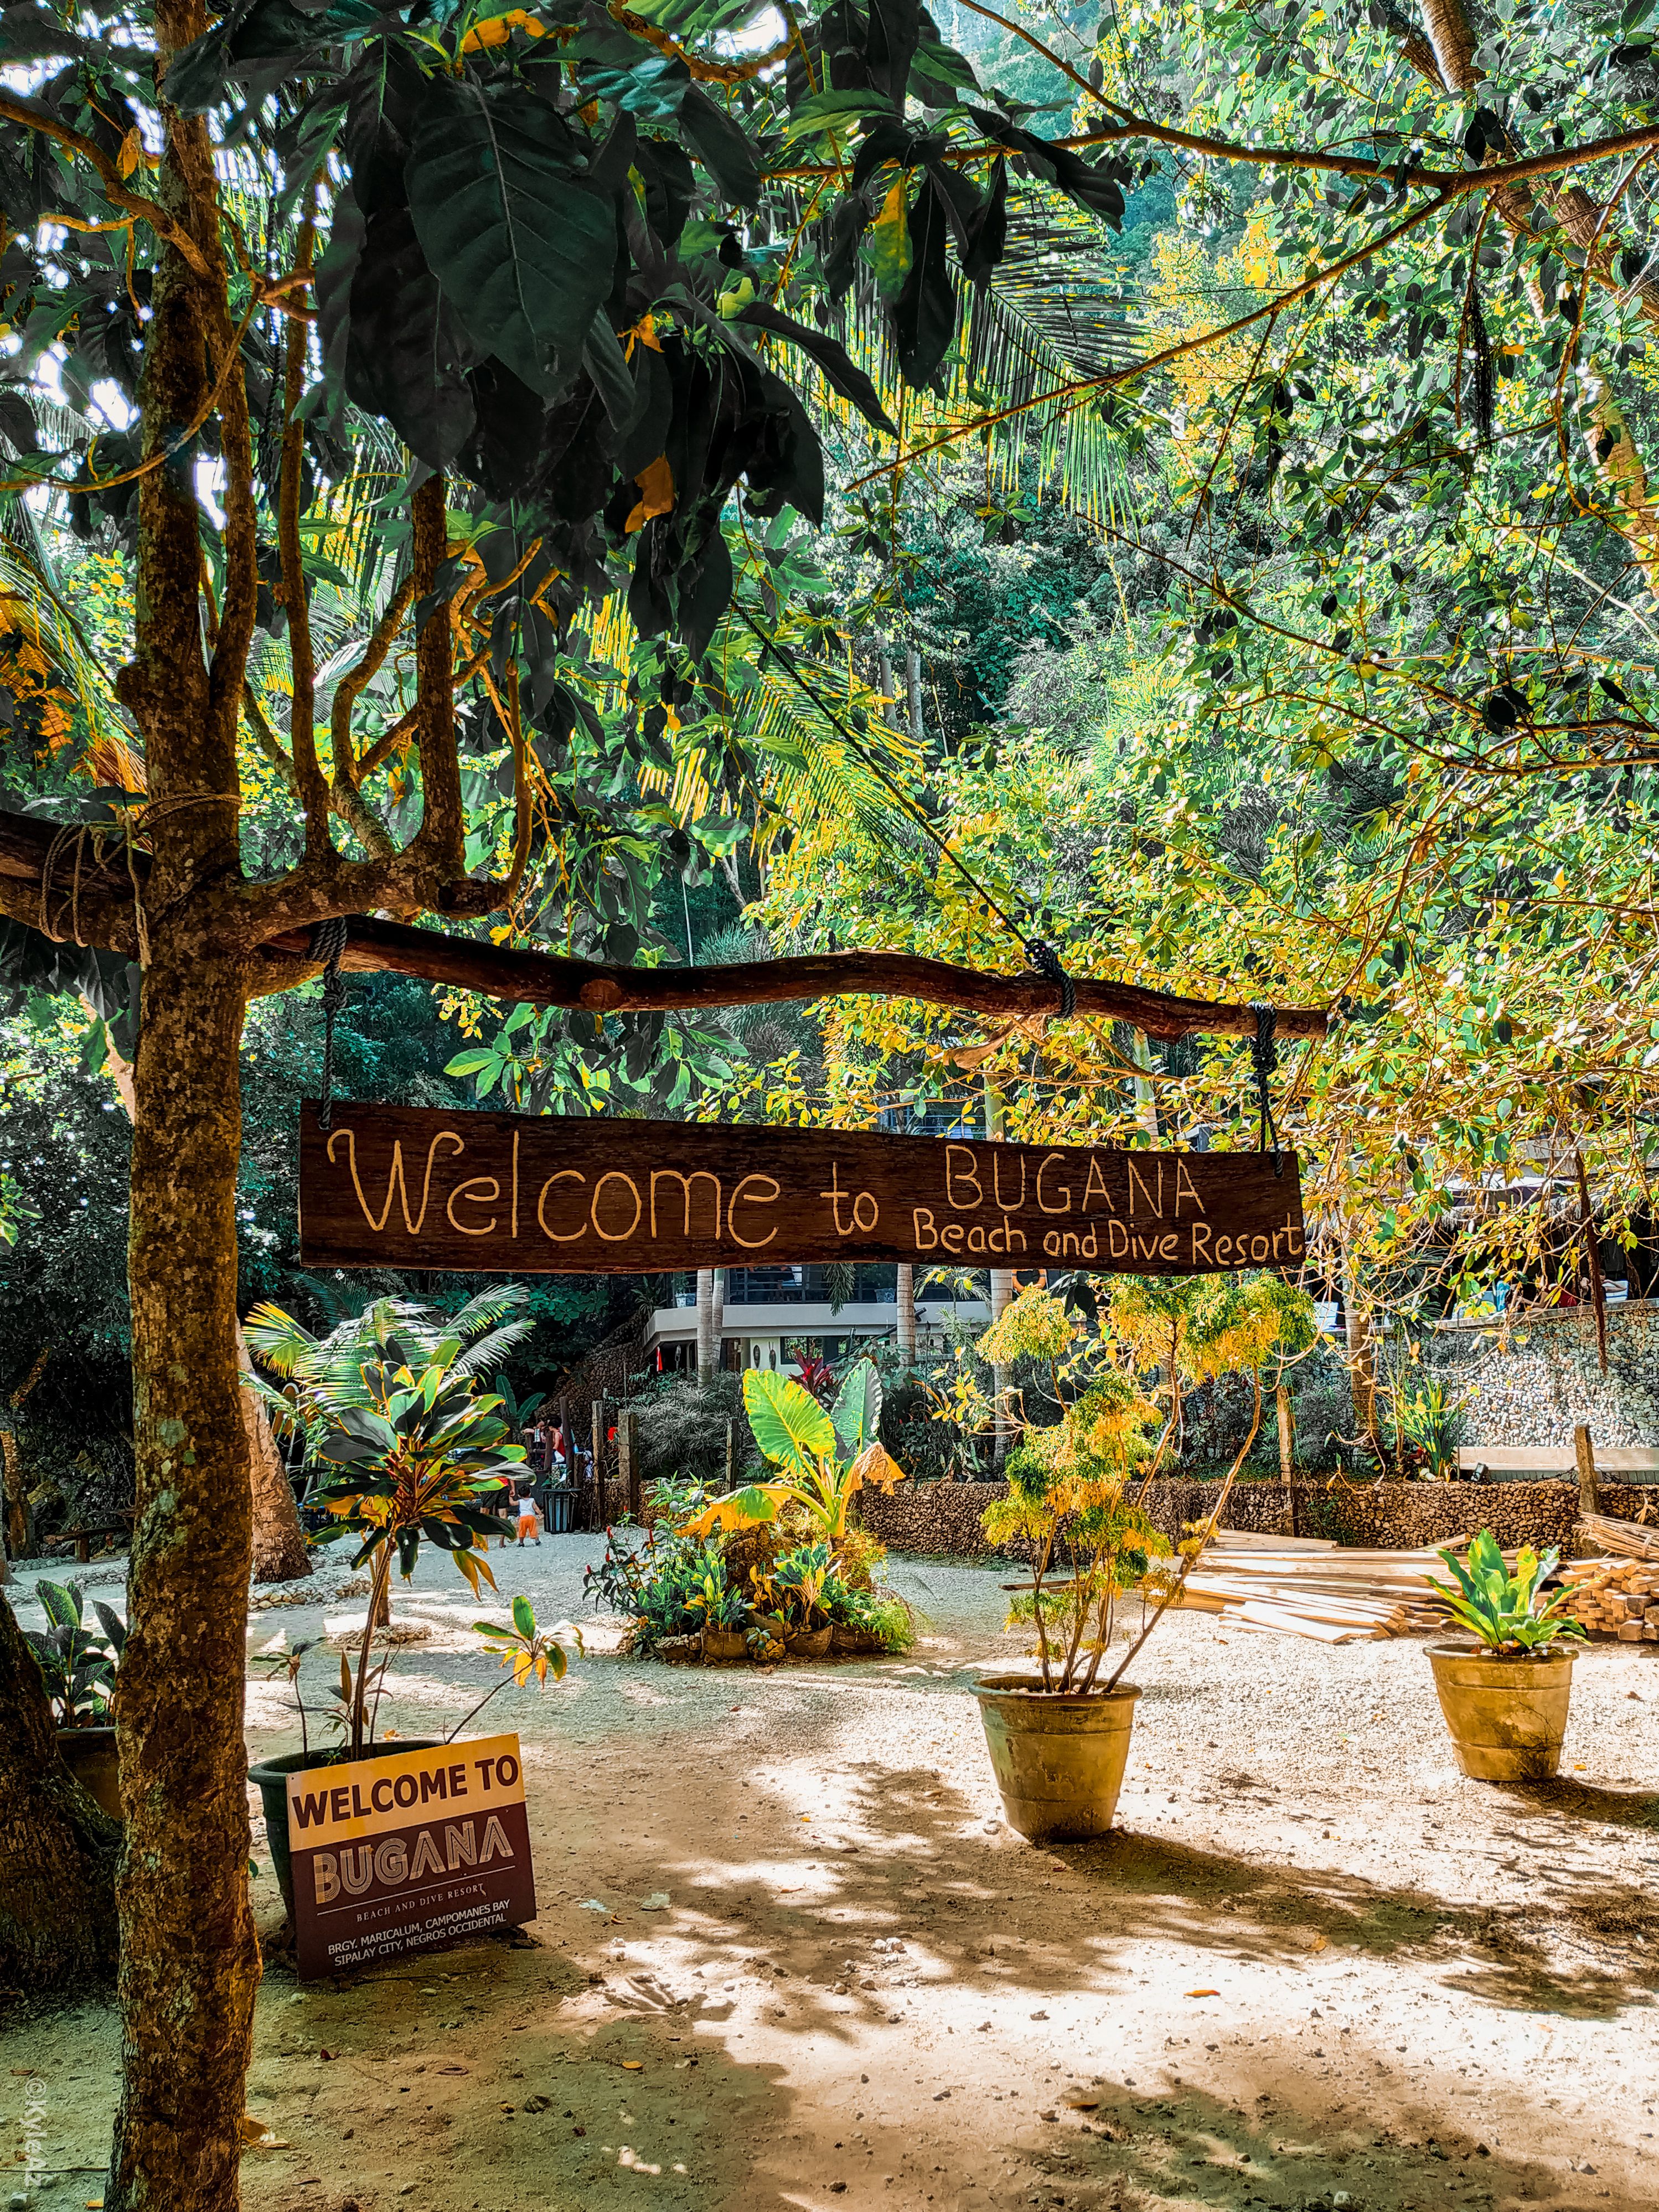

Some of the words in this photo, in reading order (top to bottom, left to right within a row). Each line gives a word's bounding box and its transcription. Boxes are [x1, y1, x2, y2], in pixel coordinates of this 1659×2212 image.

[327, 1129, 781, 1248] Welcome
[819, 1161, 880, 1236] to
[945, 1144, 1206, 1218] BUGANA
[913, 1207, 1027, 1253] Beach
[1042, 1222, 1098, 1259] and
[1108, 1218, 1179, 1261] Dive
[1192, 1212, 1304, 1266] Resort
[292, 1764, 468, 1829] WELCOME
[474, 1754, 519, 1791] TO
[313, 1815, 514, 1905] BUGANA
[328, 1939, 358, 1955] BRGY.
[361, 1922, 423, 1947] MARICALUM,
[425, 1904, 491, 1929] CAMPOMANES
[493, 1899, 510, 1912] BAY
[356, 1906, 391, 1922] BEACH
[395, 1901, 415, 1913] AND
[419, 1893, 443, 1906] DIVE
[447, 1883, 484, 1899] RESORT
[334, 1947, 376, 1966] SIPALAY
[378, 1940, 404, 1955] CITY,
[406, 1929, 446, 1947] NEGROS
[448, 1913, 507, 1936] OCCIDENTAL
